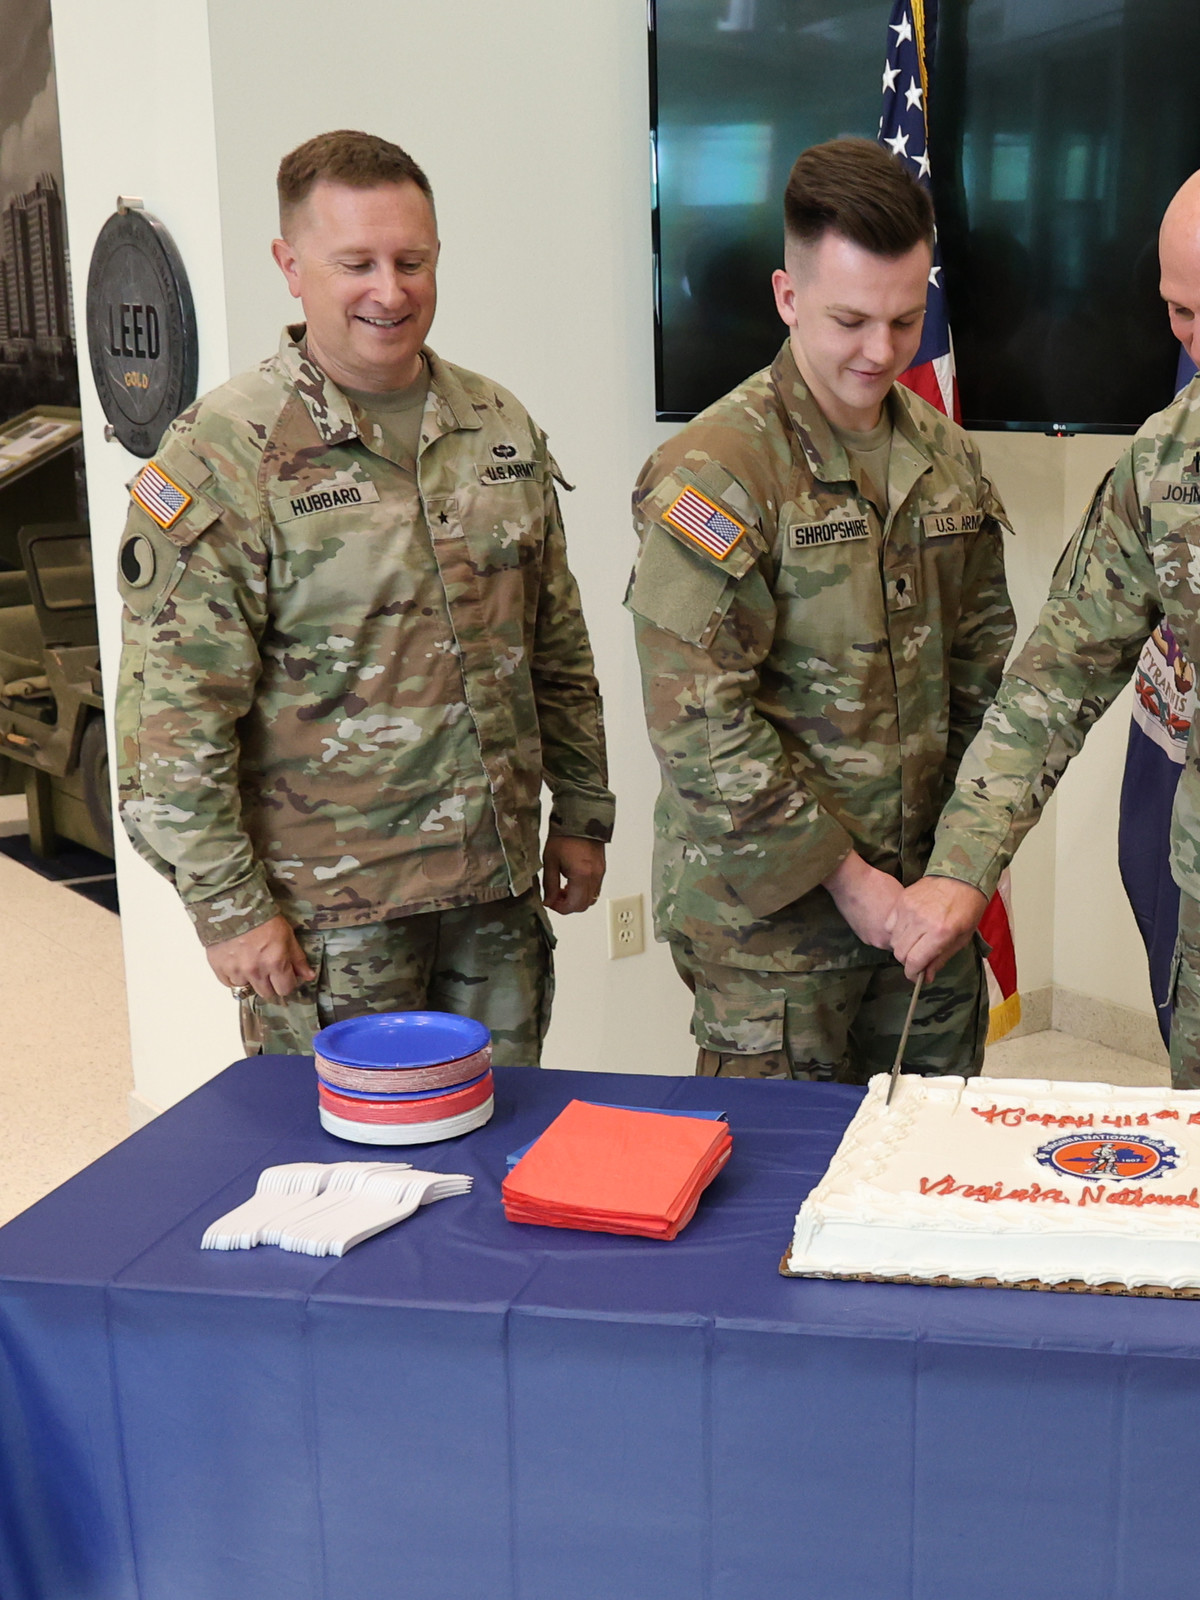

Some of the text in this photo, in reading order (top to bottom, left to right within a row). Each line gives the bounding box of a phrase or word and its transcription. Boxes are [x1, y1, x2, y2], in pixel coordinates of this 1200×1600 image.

[109, 303, 160, 360] LEED
[124, 371, 149, 389] GOLD
[507, 462, 536, 479] ARMY
[290, 486, 362, 516] HUBBARD
[795, 518, 869, 546] SHROPSHIRE
[935, 514, 981, 533] U.S. ARM
[971, 1104, 1094, 1128] Happy
[1082, 1134, 1140, 1143] NATIONAL
[919, 1174, 1070, 1203] Virginia
[1078, 1184, 1200, 1208] National
